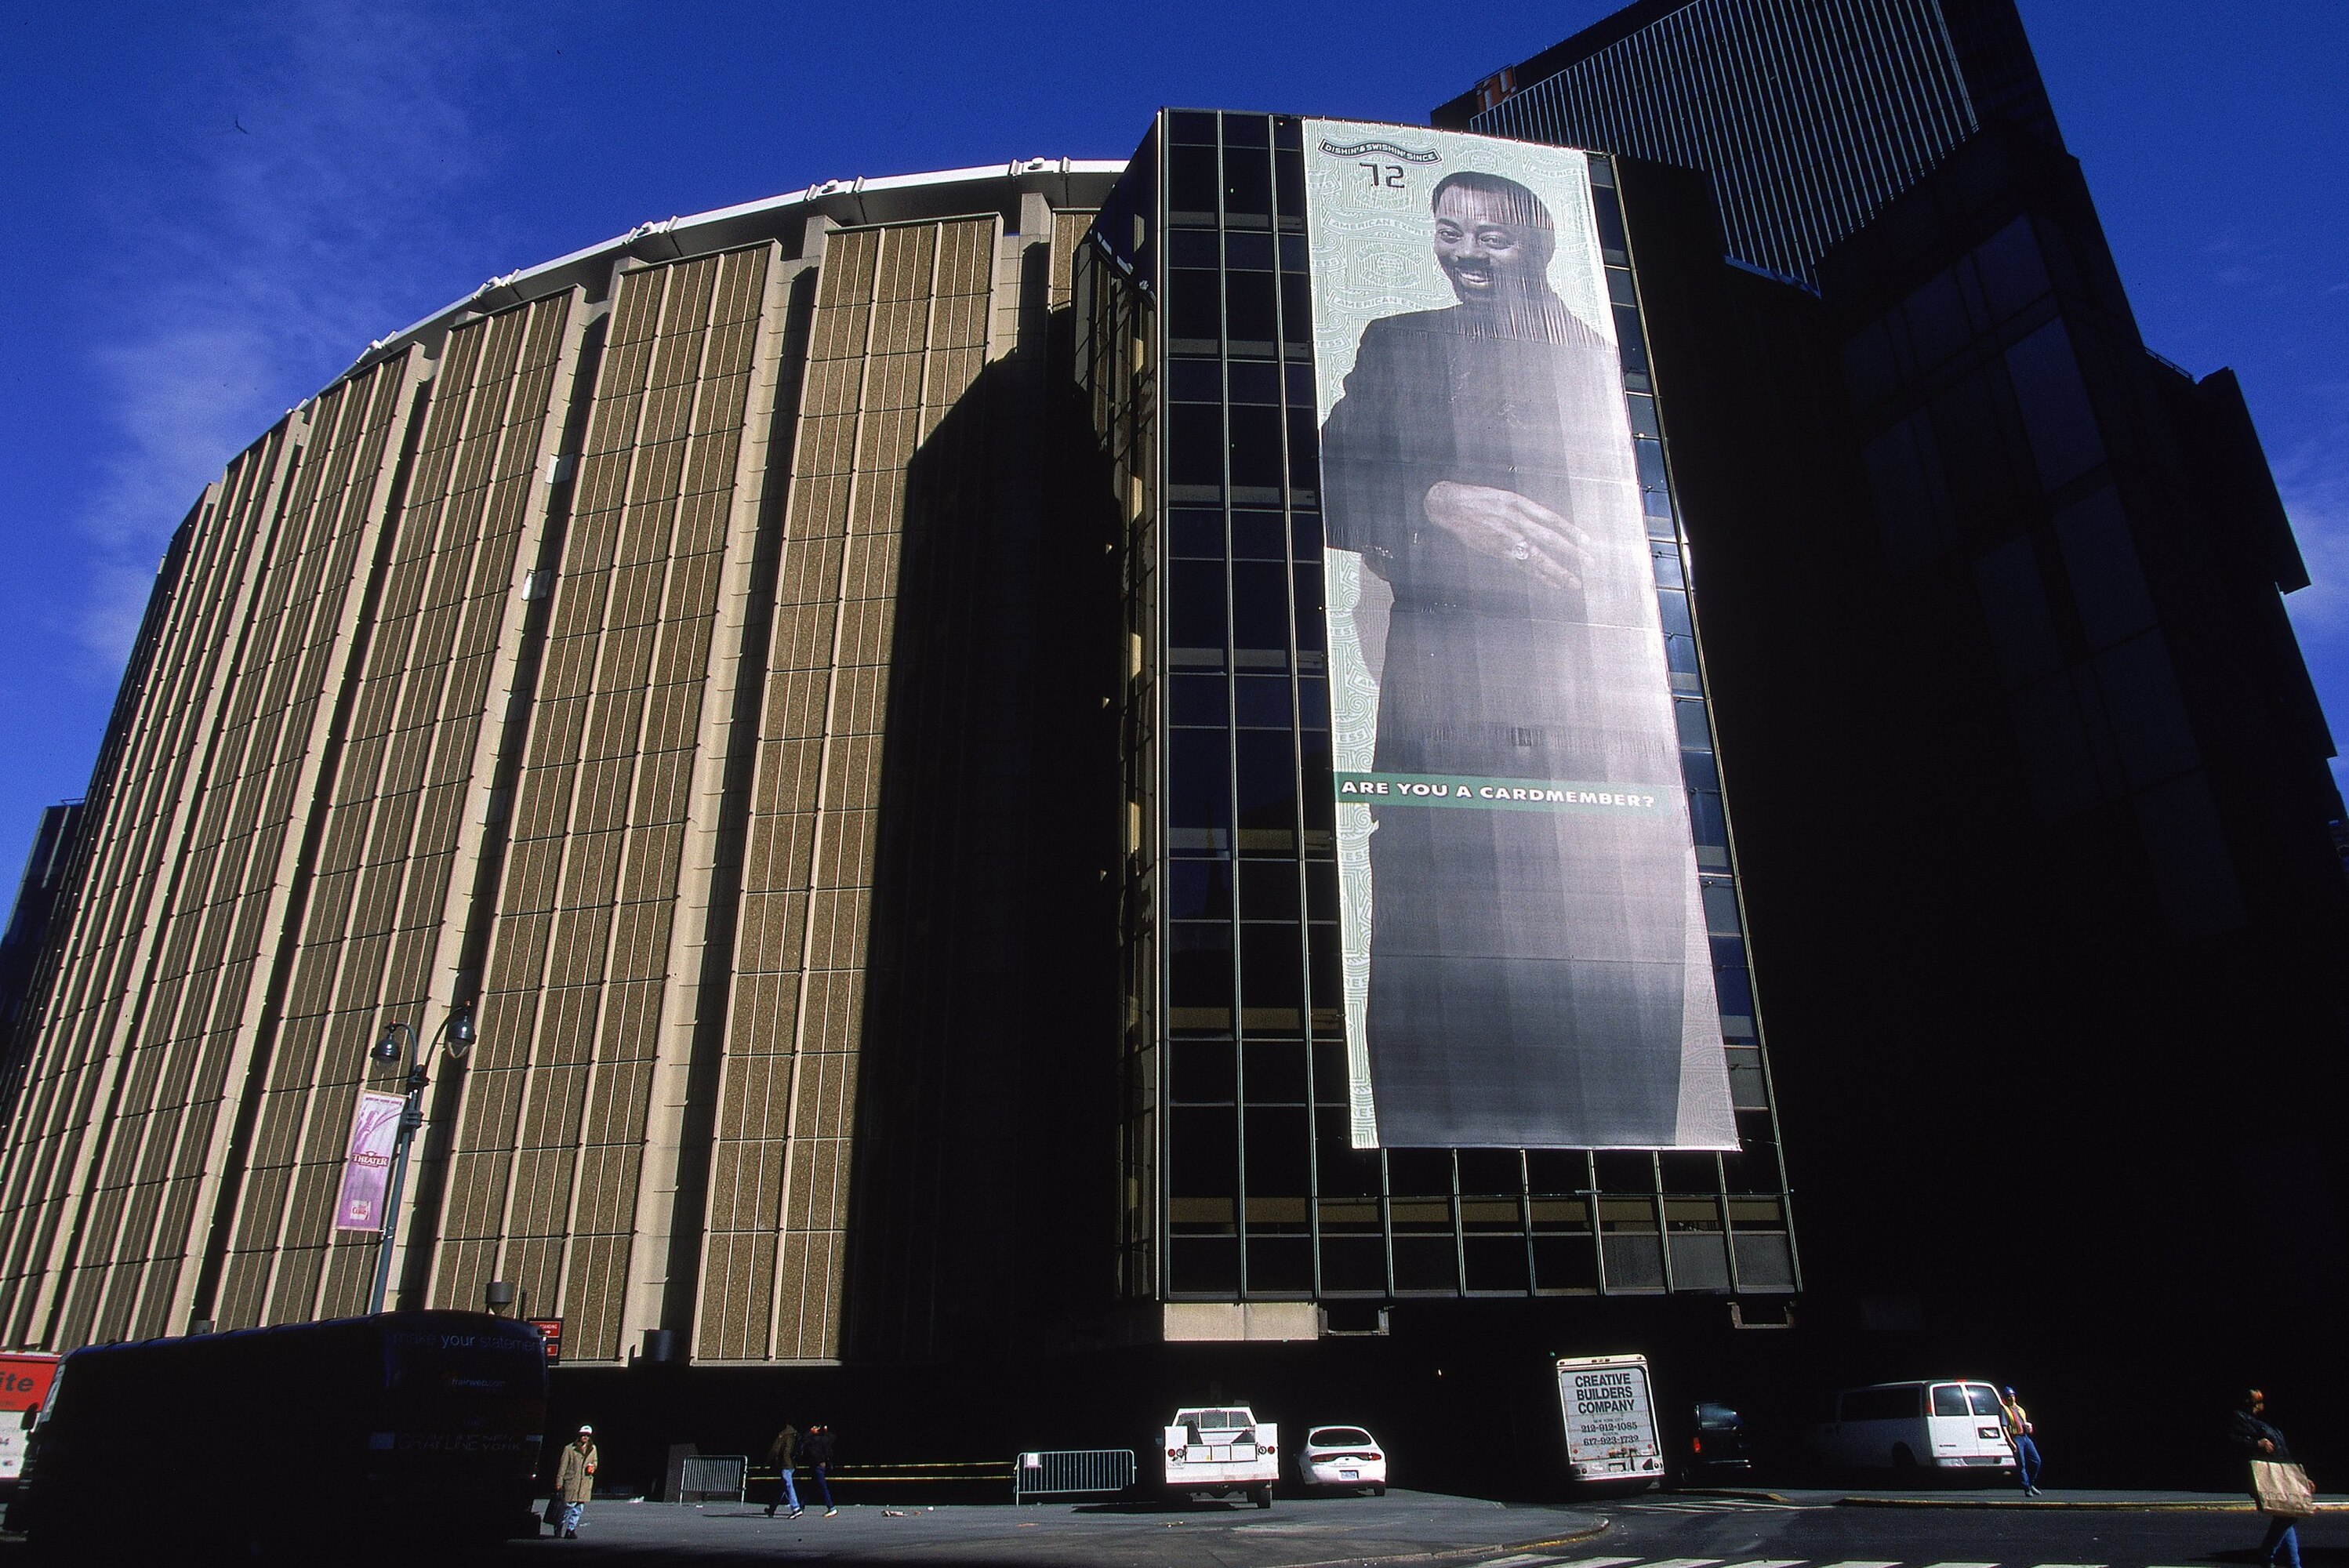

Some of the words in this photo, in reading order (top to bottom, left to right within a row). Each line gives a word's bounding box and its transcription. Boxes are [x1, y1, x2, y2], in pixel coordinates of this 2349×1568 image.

[1367, 143, 1406, 157] SWISHIN'
[1407, 153, 1435, 162] SINCE
[1359, 162, 1406, 189] 72
[1332, 220, 1390, 230] AMERICAN
[1338, 298, 1397, 308] AMERICAN
[1341, 782, 1389, 795] ARE
[1397, 782, 1448, 798] YOU
[1456, 786, 1473, 798] A
[1479, 786, 1655, 808] CARDMEMBER?
[354, 1155, 387, 1166] THEATER
[394, 1333, 437, 1345] make
[441, 1335, 476, 1349] your
[1575, 1373, 1632, 1388] CREATIVE
[1577, 1386, 1633, 1401] BUILDERS
[1578, 1399, 1635, 1414] COMPANY
[1581, 1421, 1638, 1433] 212-912-1085
